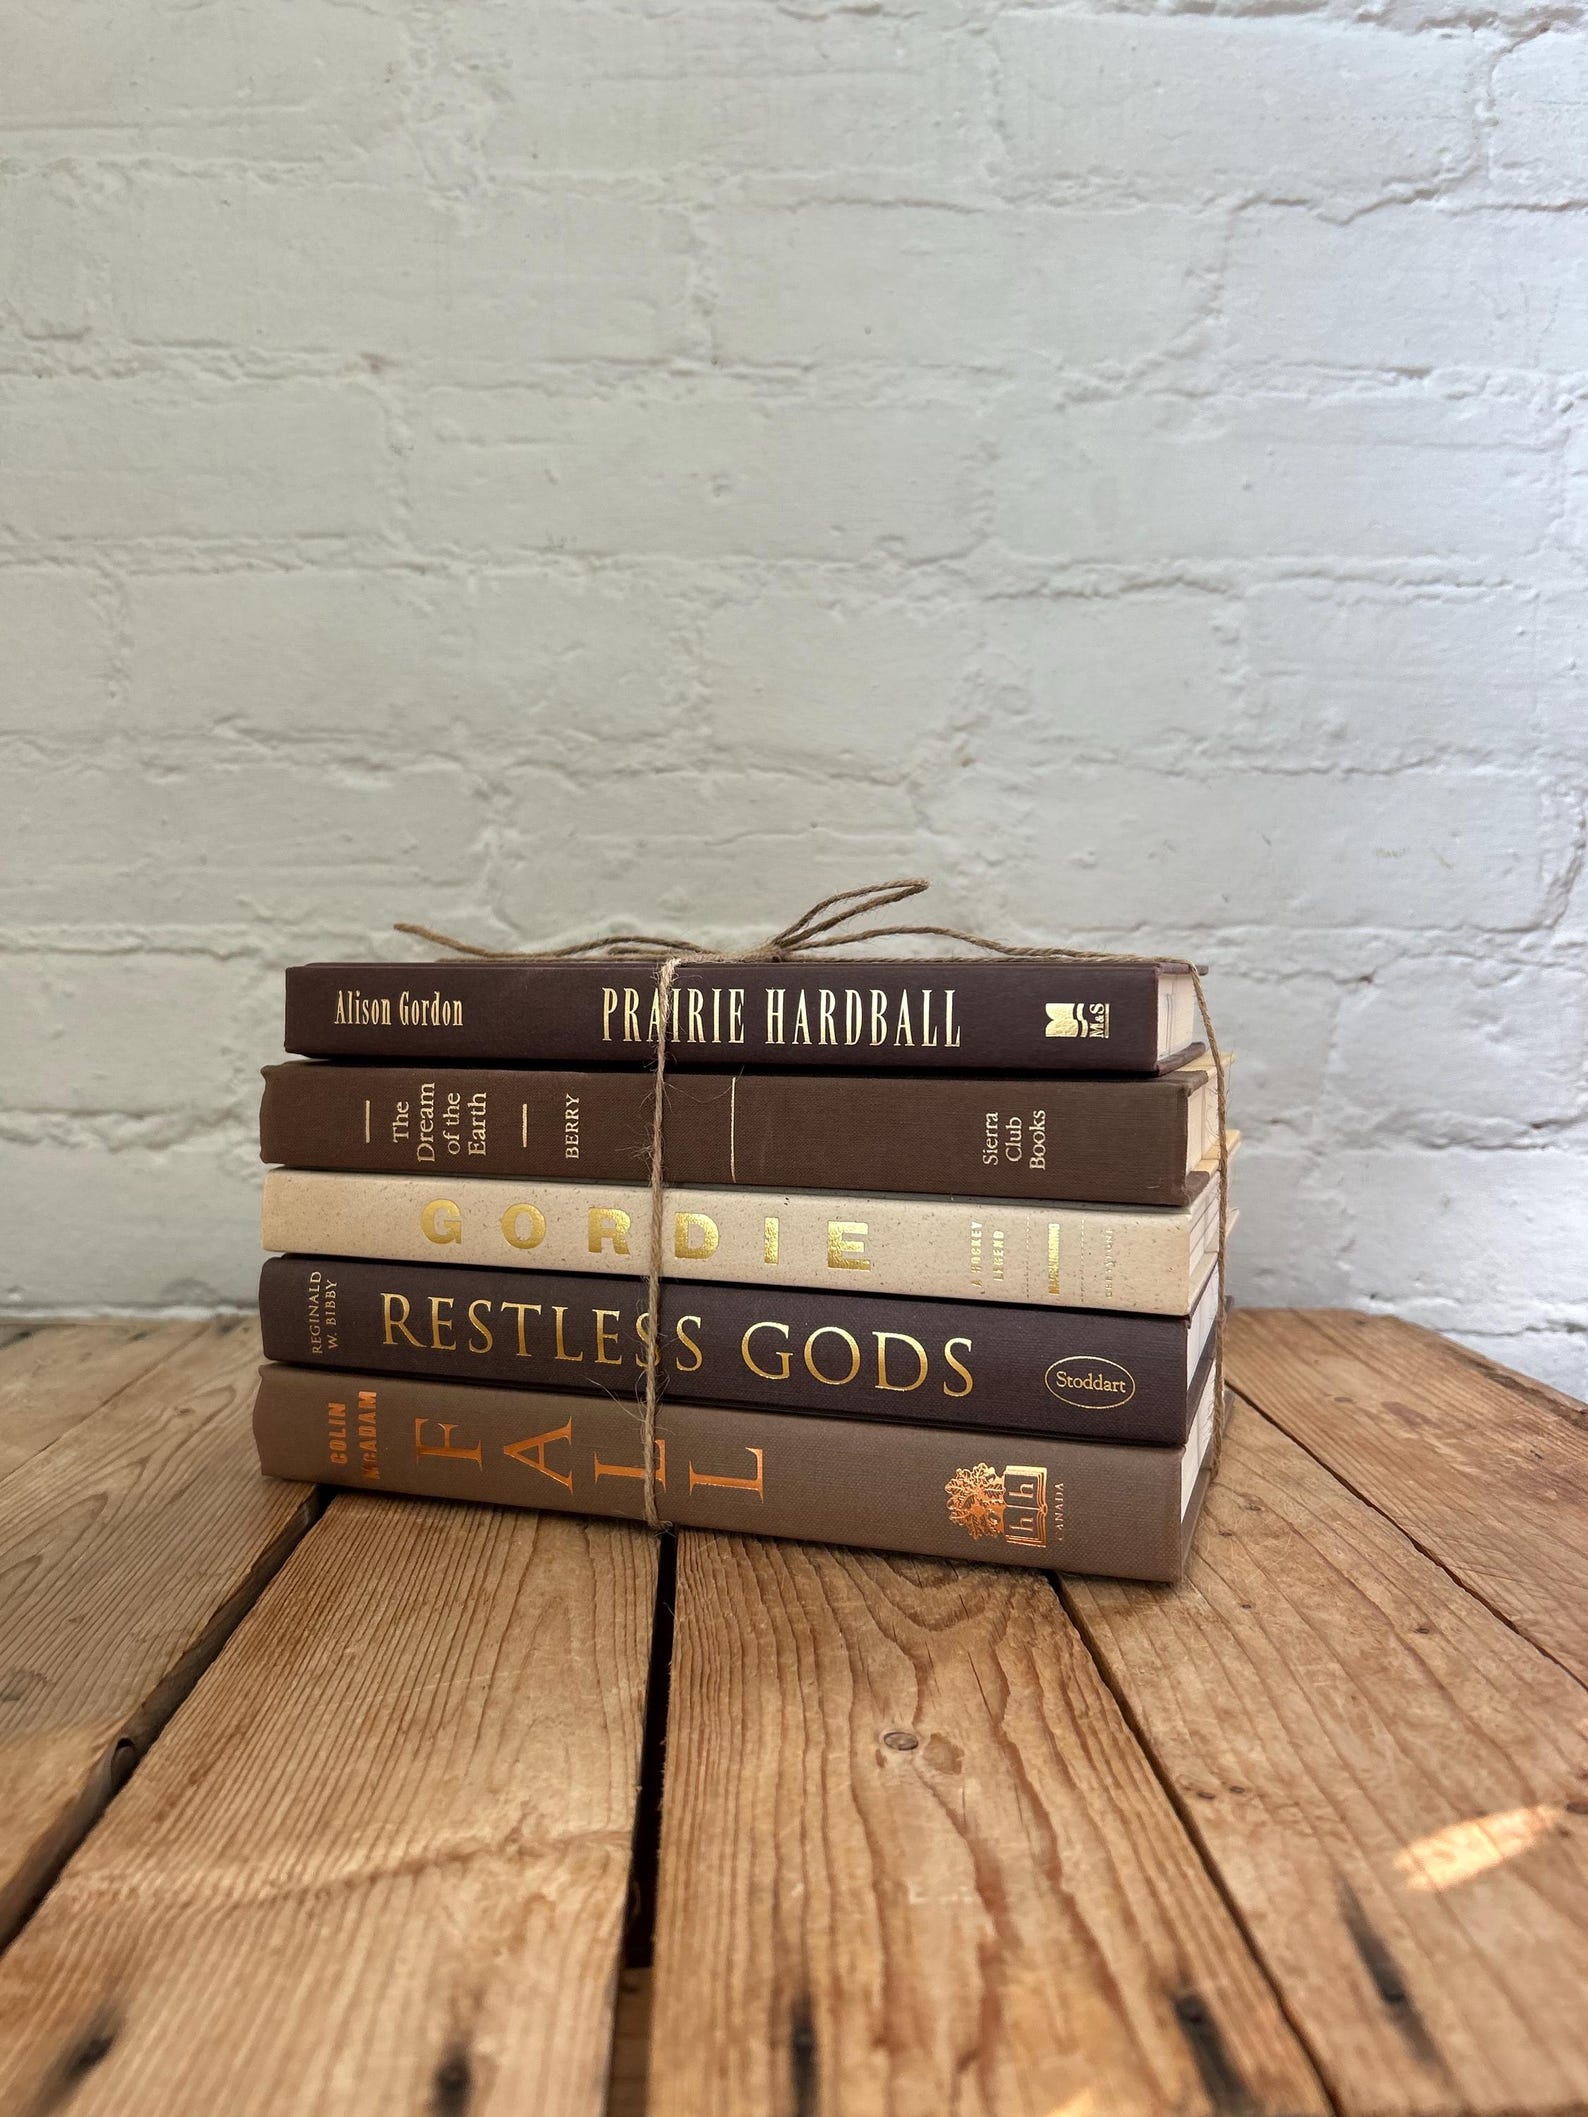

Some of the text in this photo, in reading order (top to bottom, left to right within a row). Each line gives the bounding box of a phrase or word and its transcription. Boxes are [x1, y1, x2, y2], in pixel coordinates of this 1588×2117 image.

[334, 990, 464, 1027] Alison Gordon
[601, 987, 961, 1048] PRAIRIE HARDBALL
[1089, 1003, 1105, 1038] M&S
[393, 1101, 410, 1143] The
[417, 1082, 436, 1162] Dream
[443, 1091, 462, 1155] of the
[467, 1092, 488, 1156] Earth
[565, 1094, 580, 1159] BERRY
[983, 1111, 999, 1166] Sierra
[1005, 1116, 1022, 1162] Club
[1029, 1109, 1046, 1171] Books
[420, 1199, 872, 1272] GORDIE
[970, 1221, 983, 1274] HOCKEY
[992, 1230, 1005, 1282] LEGEND
[309, 1271, 323, 1354] REGINALD
[325, 1279, 339, 1350] W. BIBBY
[381, 1292, 975, 1398] RESTLESS GODS
[1056, 1371, 1126, 1395] Stoddart
[328, 1402, 347, 1465] COLIN
[1055, 1481, 1065, 1542] CANADA
